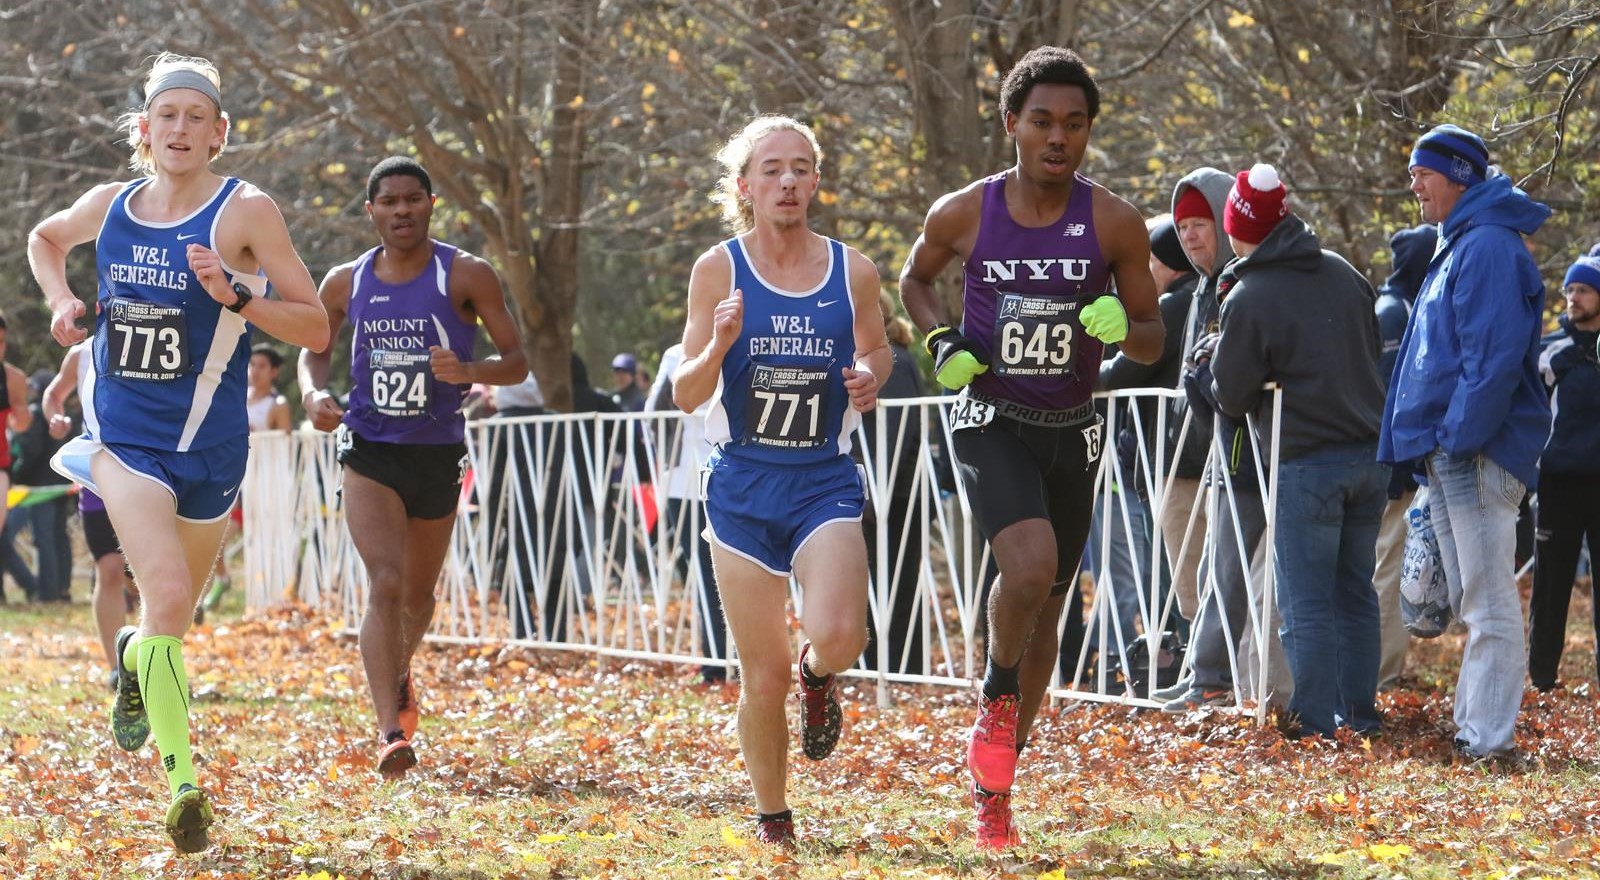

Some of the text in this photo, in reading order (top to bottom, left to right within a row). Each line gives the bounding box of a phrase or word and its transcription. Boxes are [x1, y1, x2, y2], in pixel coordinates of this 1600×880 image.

[132, 244, 170, 267] W&L
[110, 263, 188, 291] GENERALS
[982, 258, 1091, 283] NYU
[127, 305, 149, 315] CROSS
[149, 307, 181, 316] COUNTRY
[1022, 301, 1077, 311] CROSS COUNTRY
[363, 318, 428, 334] MOUNT
[770, 315, 815, 335] W&L
[114, 323, 182, 371] 773
[369, 336, 425, 350] UNION
[749, 337, 834, 358] GENERALS
[1001, 321, 1073, 366] 643
[121, 370, 152, 379] NOVEMBER
[773, 371, 828, 380] CROSS COUNTRY
[1006, 367, 1039, 375] NOVEMBER
[372, 370, 427, 408] 624
[754, 390, 820, 437] 771
[951, 398, 989, 428] 643
[1003, 404, 1042, 423] PRO
[758, 436, 789, 447] NOVEMBER
[798, 440, 813, 448] 2016
